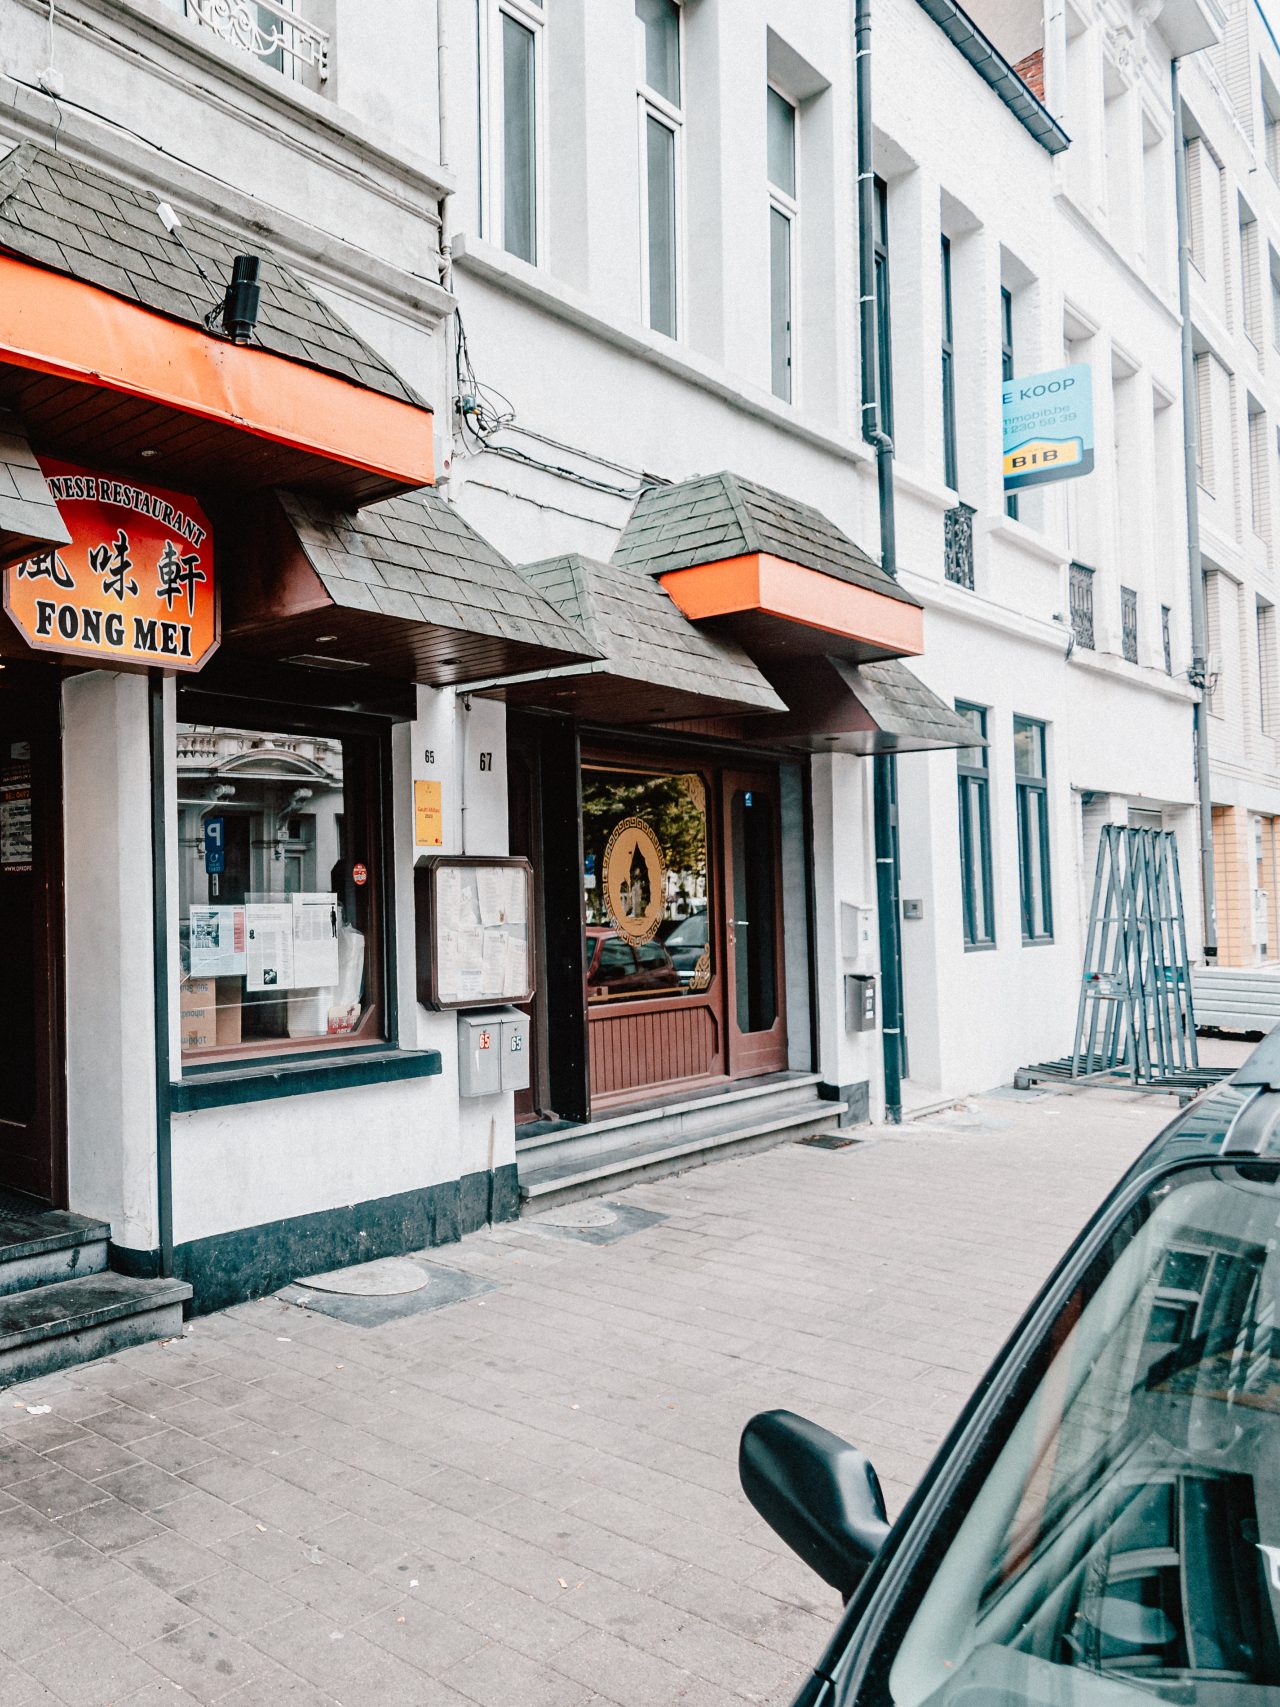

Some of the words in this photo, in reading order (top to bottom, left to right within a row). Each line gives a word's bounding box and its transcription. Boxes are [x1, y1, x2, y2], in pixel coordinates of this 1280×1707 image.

[1020, 378, 1075, 400] KOOP
[1012, 450, 1058, 468] BIB
[99, 478, 206, 548] RESTAURANT
[36, 600, 125, 646] FONG
[133, 617, 193, 658] MEI
[425, 750, 435, 764] 65
[480, 752, 492, 771] 67
[480, 1033, 489, 1049] 65
[512, 1036, 521, 1051] 65
